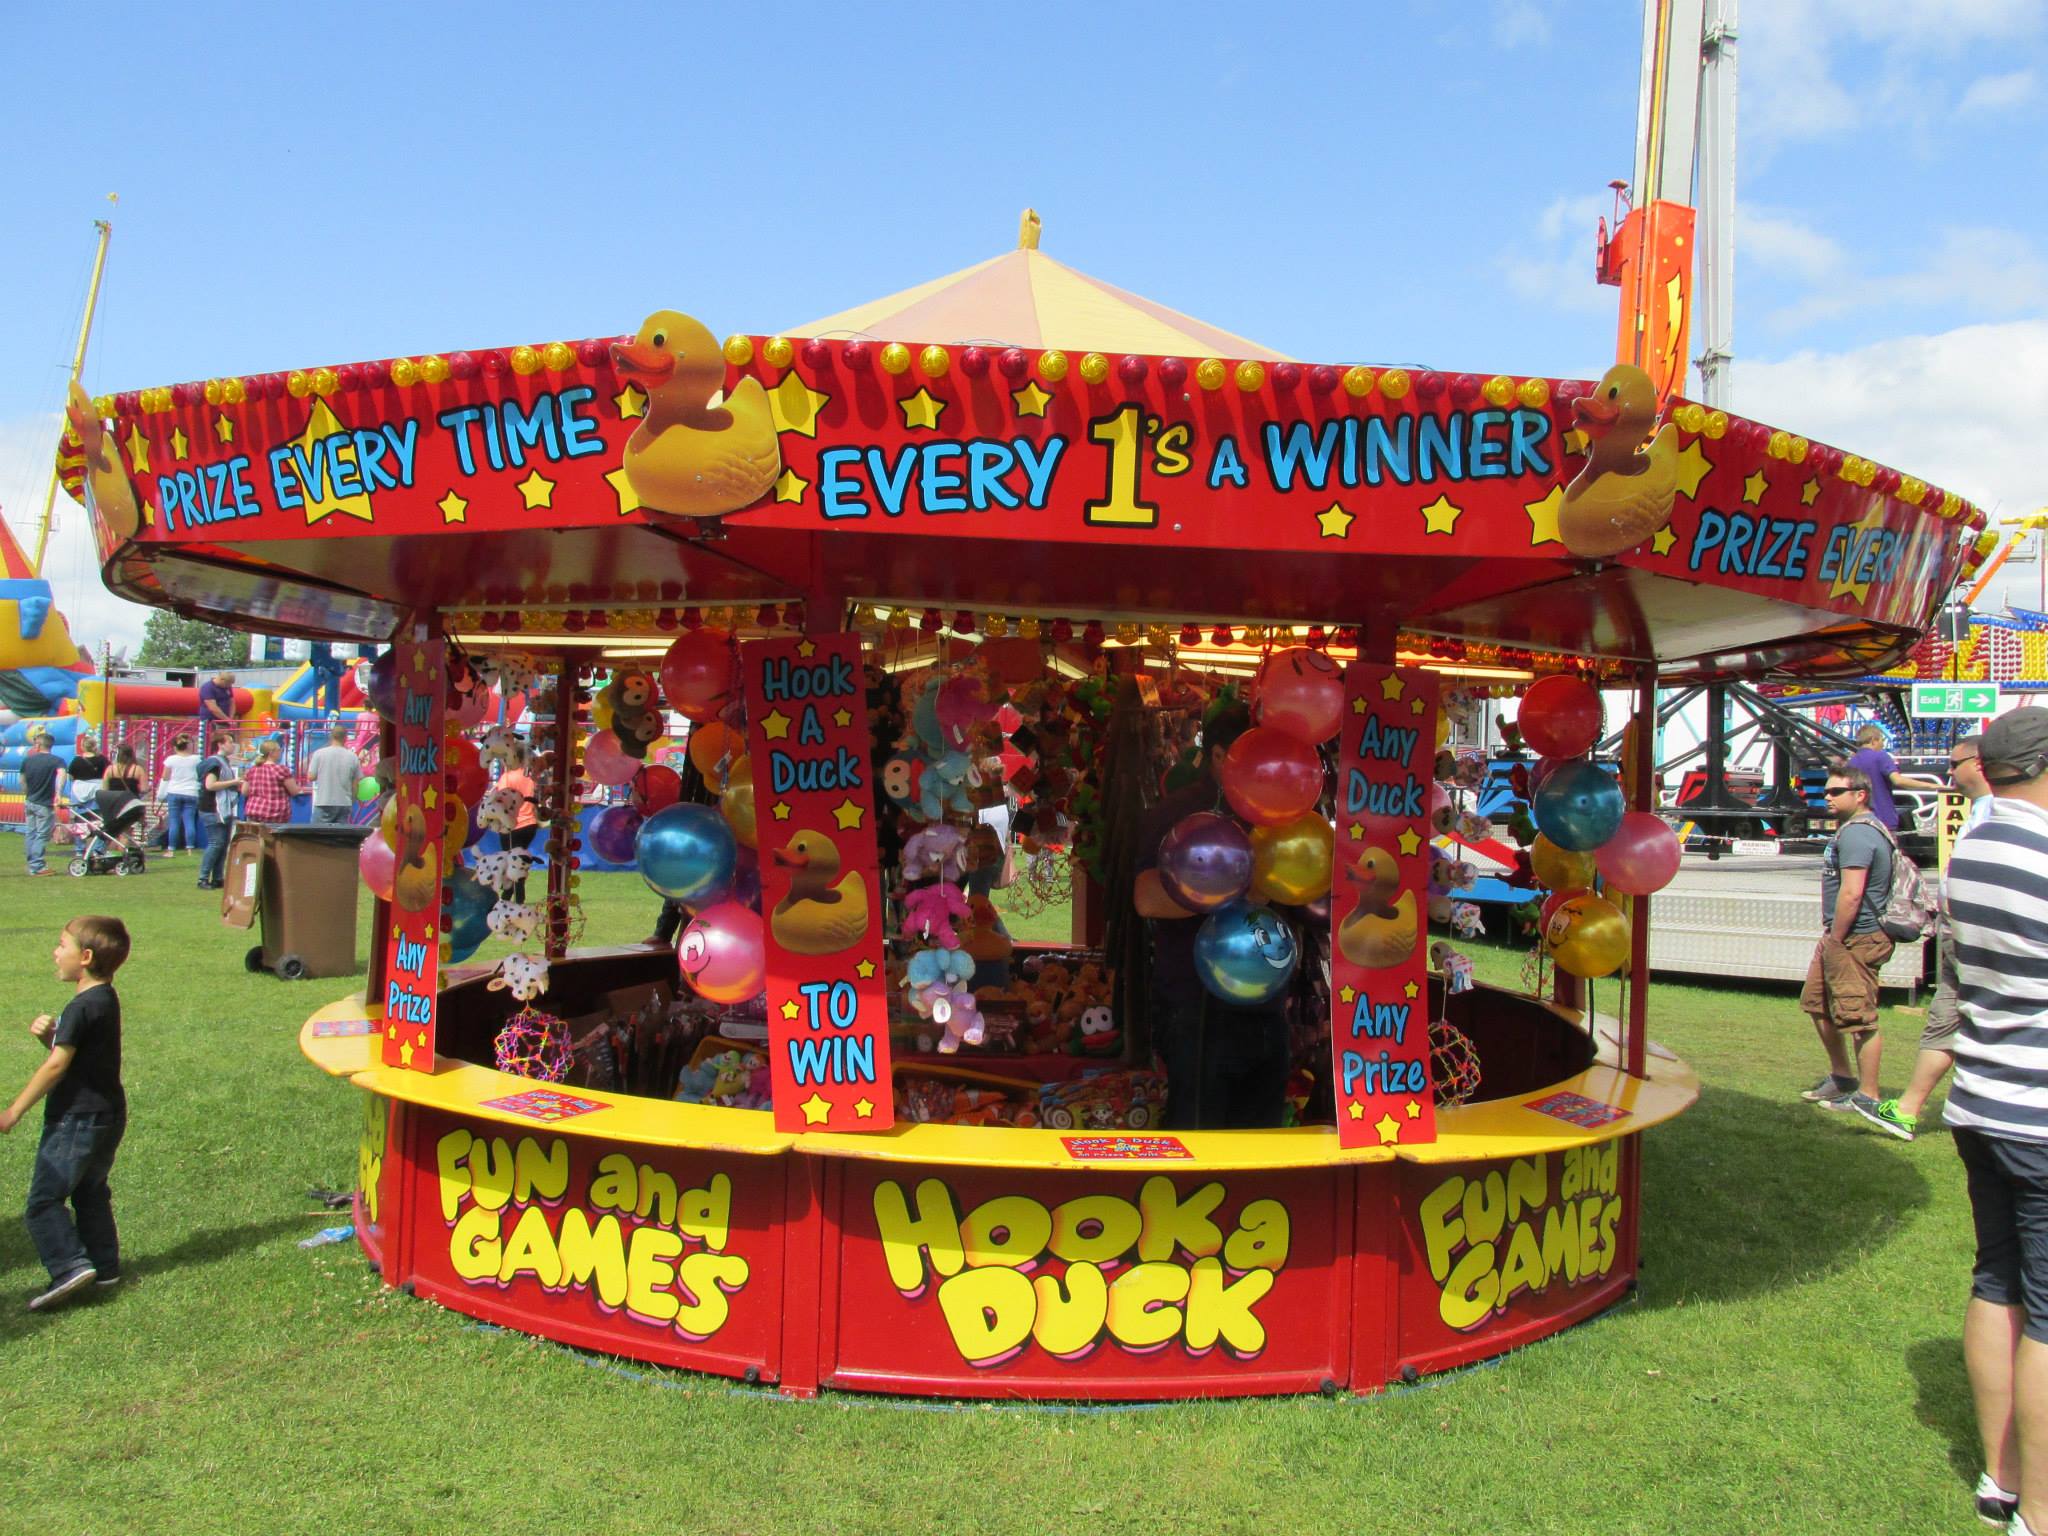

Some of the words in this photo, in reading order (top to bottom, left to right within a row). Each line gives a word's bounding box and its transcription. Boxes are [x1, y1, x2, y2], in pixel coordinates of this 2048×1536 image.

[158, 455, 261, 531] PRIZE
[268, 419, 418, 511] EVERY
[440, 387, 605, 477] TIME
[819, 436, 1064, 518] EVERY
[1208, 437, 1248, 488] A
[1264, 408, 1552, 490] WINNER
[1690, 508, 1815, 580] PRIZE
[763, 655, 856, 702] Hook
[1920, 695, 1941, 704] Exit
[404, 688, 433, 730] Any
[799, 706, 824, 745] A
[400, 737, 438, 774] Duck
[1359, 715, 1418, 768] Any
[771, 748, 862, 793] Duck
[1348, 770, 1424, 817] Duck
[396, 932, 428, 974] Any
[388, 981, 432, 1024] Prize
[800, 981, 858, 1030] TO
[1351, 994, 1410, 1044] Any
[789, 1035, 876, 1085] WIN
[1341, 1050, 1427, 1097] Prize
[437, 1128, 569, 1226] FUN
[590, 1153, 733, 1253] and
[1419, 1153, 1547, 1285] FUN
[1561, 1138, 1618, 1201] and
[1224, 1199, 1290, 1276] a
[450, 1205, 750, 1342] GAMES
[1439, 1195, 1622, 1333] GAMES
[938, 1256, 1276, 1369] DUCK
